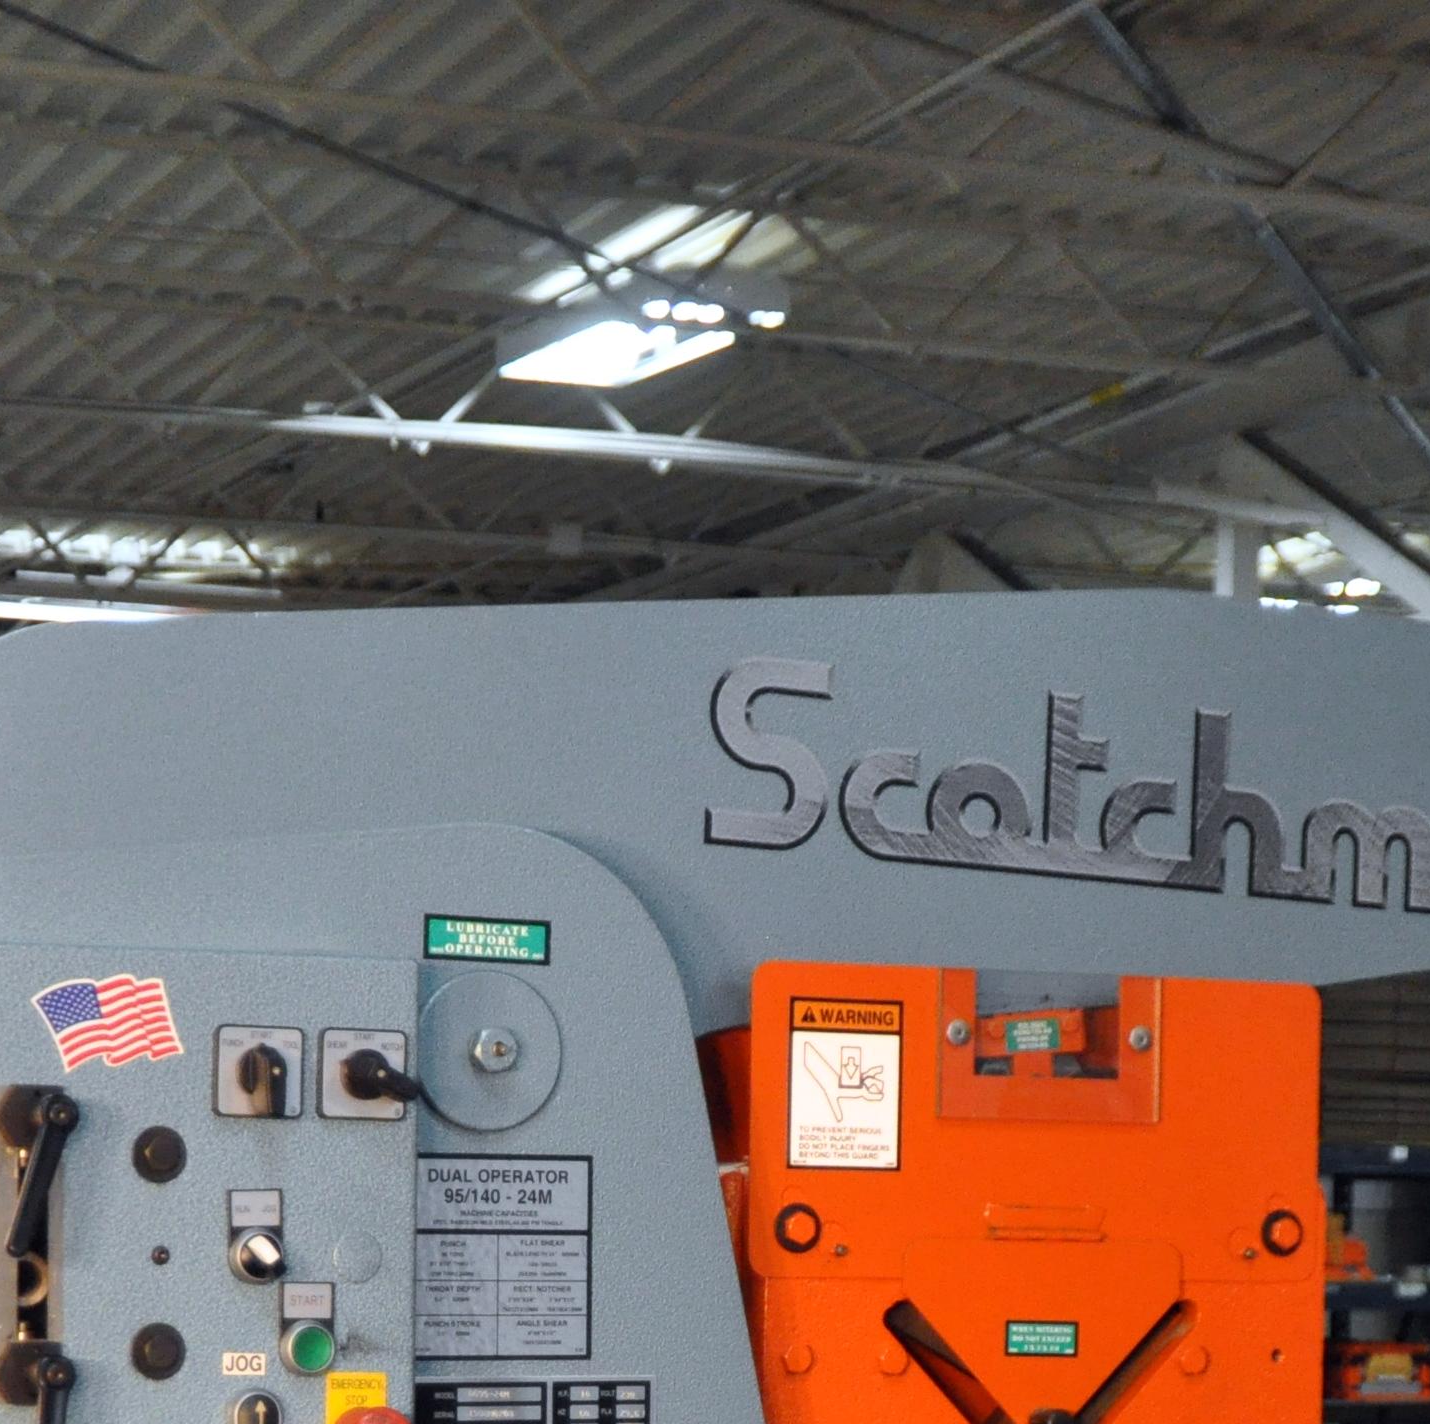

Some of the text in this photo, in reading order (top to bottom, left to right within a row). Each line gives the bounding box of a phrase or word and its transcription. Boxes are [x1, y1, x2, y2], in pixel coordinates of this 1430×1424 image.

[446, 921, 529, 936] LUBRICATE
[458, 933, 516, 946] BEFORE
[444, 943, 529, 958] OPERATING
[820, 1008, 894, 1026] WARNING
[427, 1168, 569, 1184] DUAL OPERATOR
[444, 1188, 501, 1204] 95/140
[517, 1189, 552, 1204] 24M
[289, 1295, 324, 1306] START
[225, 1355, 262, 1372] JOG
[331, 1379, 382, 1390] EMERGENCY
[345, 1395, 368, 1405] STOP
